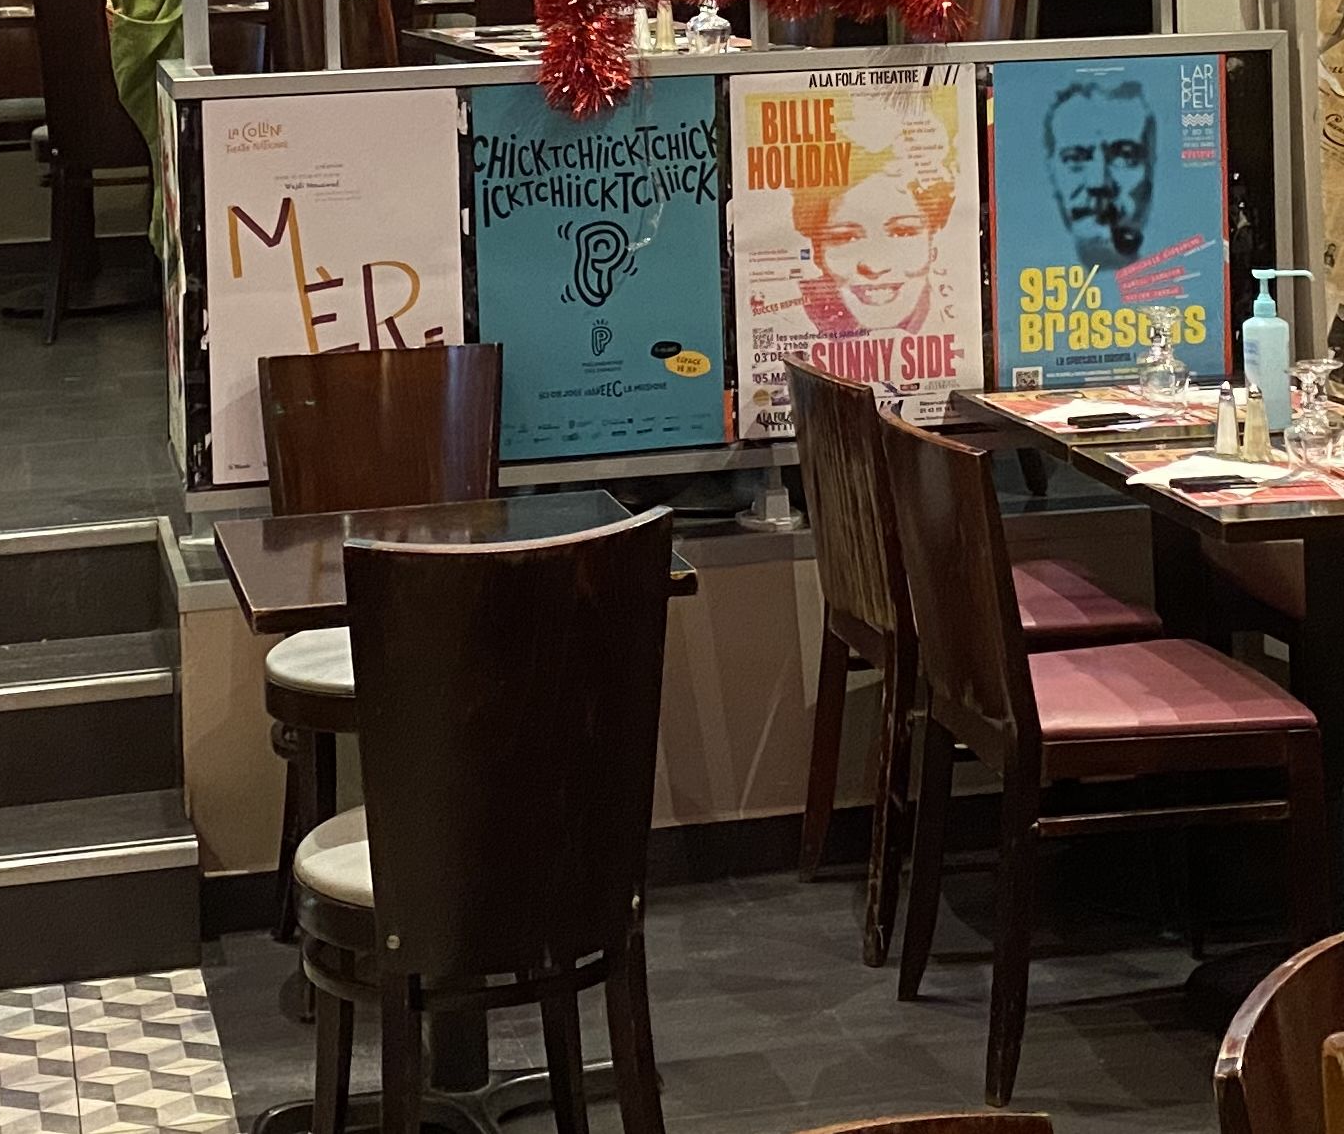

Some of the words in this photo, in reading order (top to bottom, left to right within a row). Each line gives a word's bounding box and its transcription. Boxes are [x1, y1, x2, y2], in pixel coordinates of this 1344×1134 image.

[809, 74, 817, 88] A
[819, 73, 833, 87] LA
[836, 71, 866, 87] FOLIE
[869, 69, 919, 84] THEATRE
[1181, 64, 1213, 79] LAR
[1181, 92, 1213, 108] PEL
[761, 98, 836, 144] BILLIE
[228, 128, 239, 139] LA
[747, 142, 851, 191] HOLIDAY
[1020, 264, 1101, 313] 95%
[776, 333, 787, 341] les
[790, 331, 827, 340] vendredis
[754, 352, 767, 363] 03
[770, 351, 786, 362] DE
[812, 338, 894, 383] SUNNY
[901, 334, 957, 380] SIDE
[755, 373, 768, 384] 05
[771, 372, 787, 383] MA
